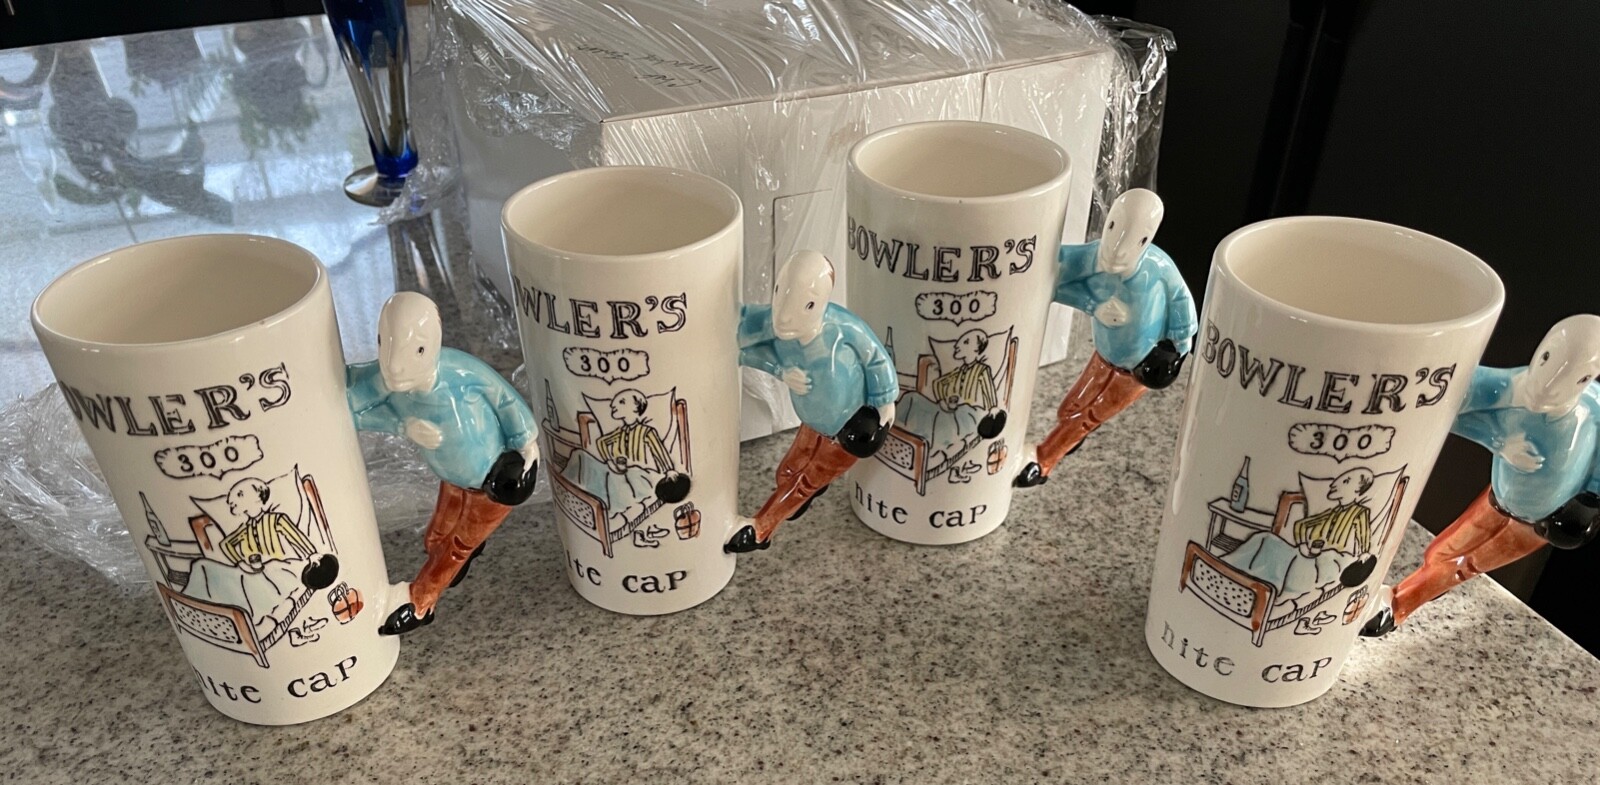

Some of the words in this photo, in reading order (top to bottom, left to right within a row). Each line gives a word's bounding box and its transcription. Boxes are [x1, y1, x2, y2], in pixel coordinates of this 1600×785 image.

[847, 216, 1036, 283] BOWLER'S
[512, 275, 687, 339] WLER'S
[932, 298, 981, 316] 300
[579, 354, 631, 374] 300
[1201, 318, 1457, 415] BOWLER'S
[178, 446, 239, 473] 300
[1309, 430, 1373, 451] 300
[854, 480, 908, 525] nite
[1160, 621, 1236, 678] nite
